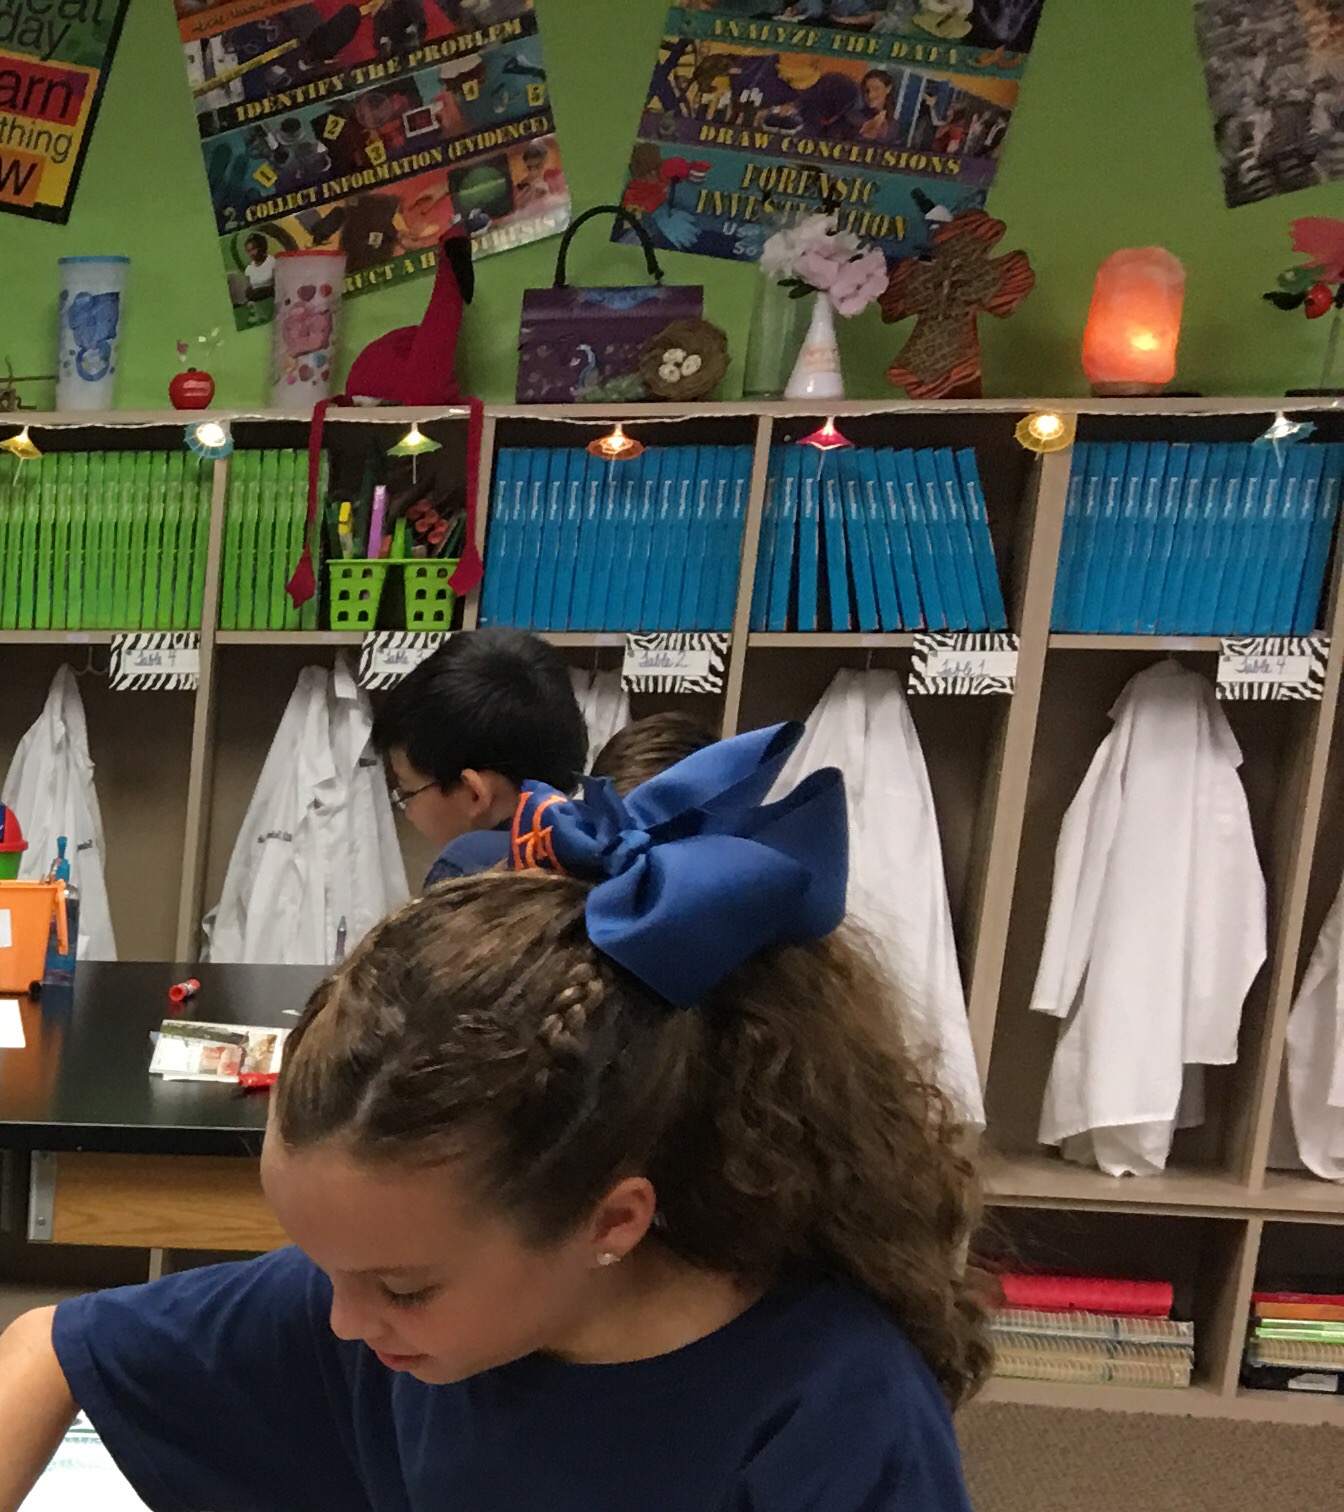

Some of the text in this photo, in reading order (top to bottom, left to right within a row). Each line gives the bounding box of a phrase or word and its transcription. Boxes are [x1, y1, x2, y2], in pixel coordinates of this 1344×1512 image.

[714, 18, 958, 65] ANALYZE THE DATA
[235, 76, 345, 122] IDENTIFY
[351, 57, 402, 85] THE
[408, 18, 523, 69] PROBLEM
[245, 186, 316, 222] COLLECT
[322, 150, 442, 198] INFORMATION
[448, 116, 549, 161] (EVIDENCE)
[699, 124, 963, 175] DRAW CONCLUSIONS
[741, 163, 880, 204] FORENSIC
[134, 650, 163, 667] Table
[639, 650, 689, 668] Table 2
[936, 658, 975, 678] Table
[1234, 655, 1286, 676] Table 4
